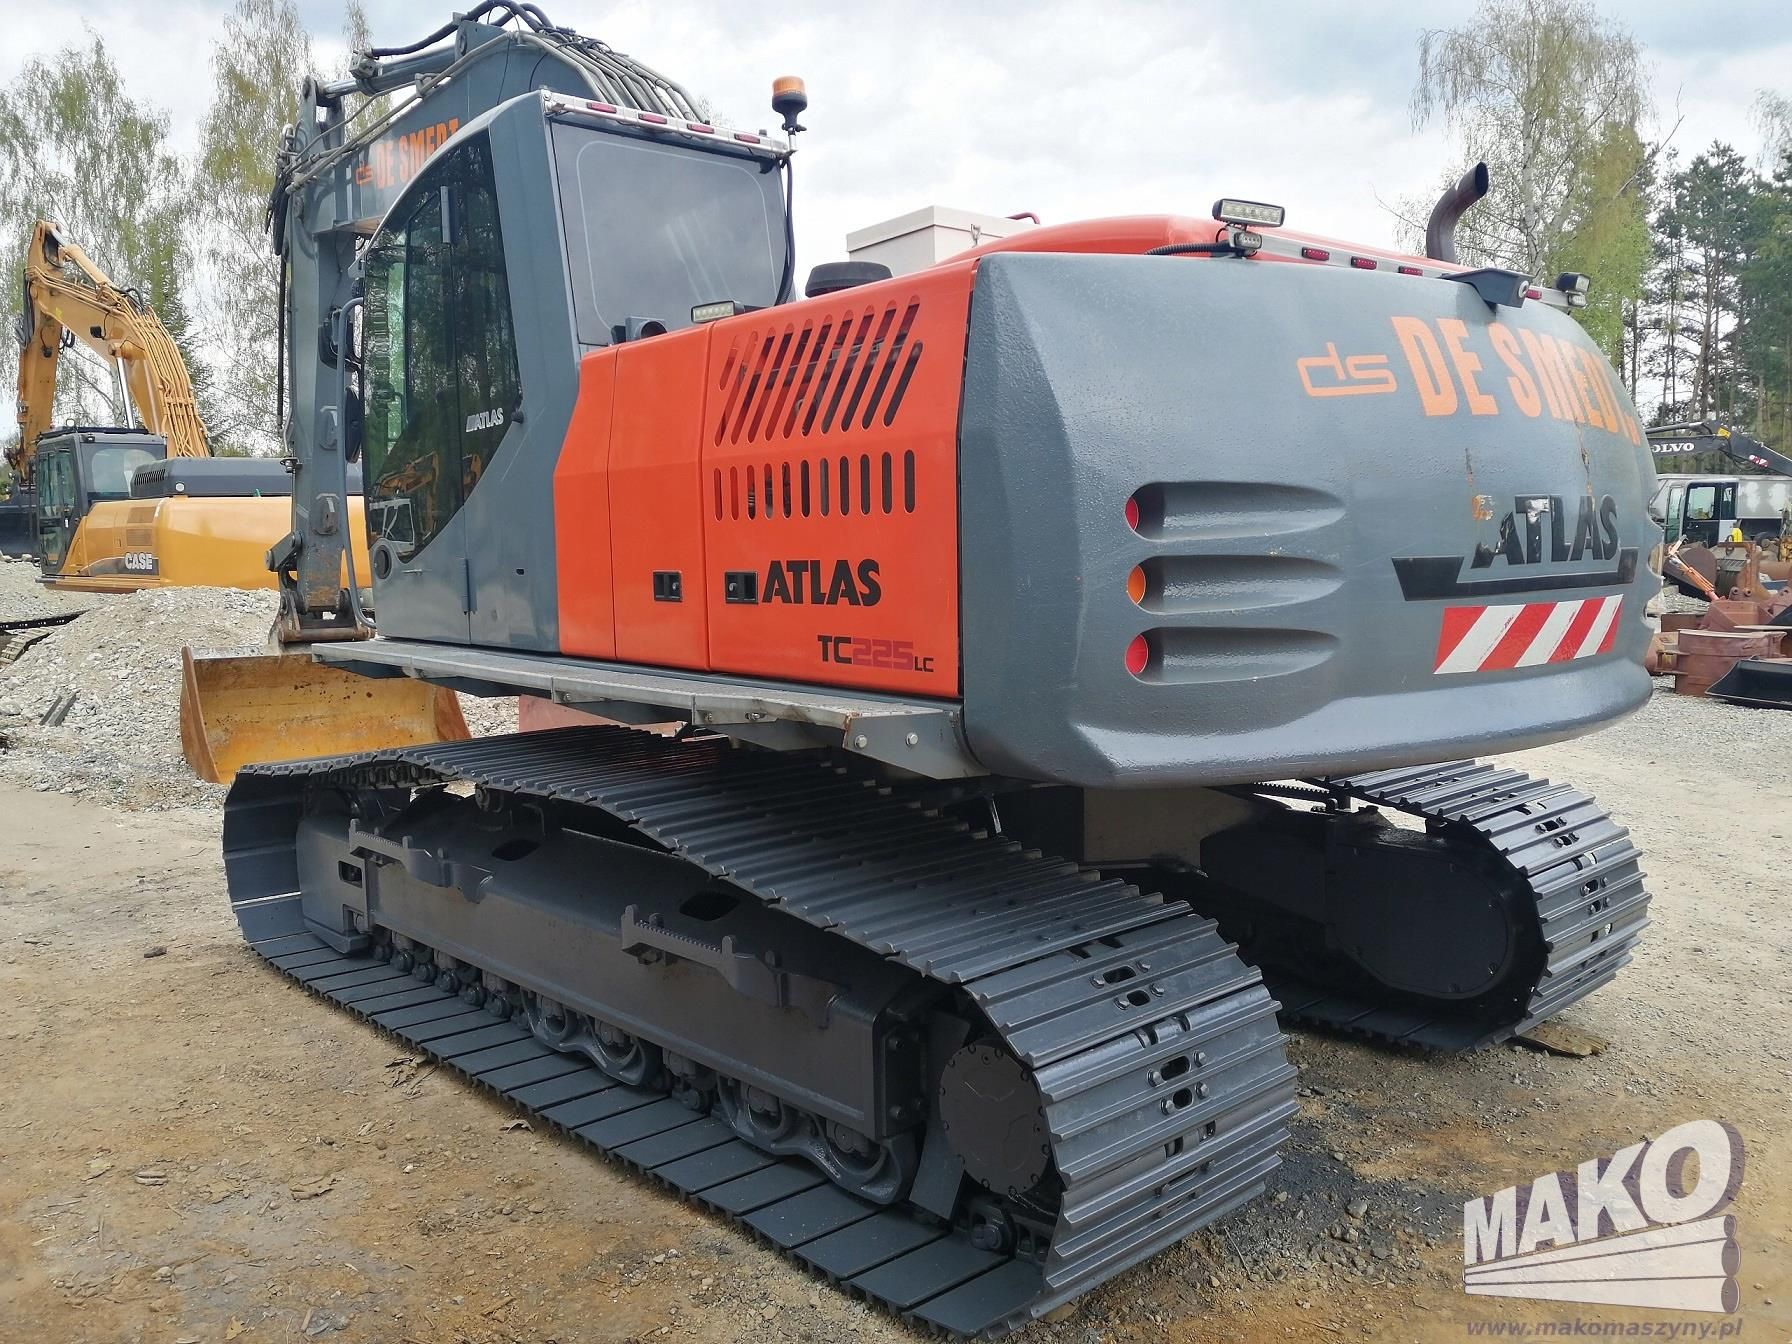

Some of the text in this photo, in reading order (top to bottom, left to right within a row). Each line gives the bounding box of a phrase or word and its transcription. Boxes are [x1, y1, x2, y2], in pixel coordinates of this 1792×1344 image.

[376, 140, 395, 189] DE
[1391, 316, 1498, 416] DE
[470, 407, 504, 431] ATLAS
[1650, 443, 1695, 453] OLVO
[1471, 494, 1619, 569] ATLAS
[125, 552, 153, 570] CASE
[762, 558, 882, 607] ATLAS
